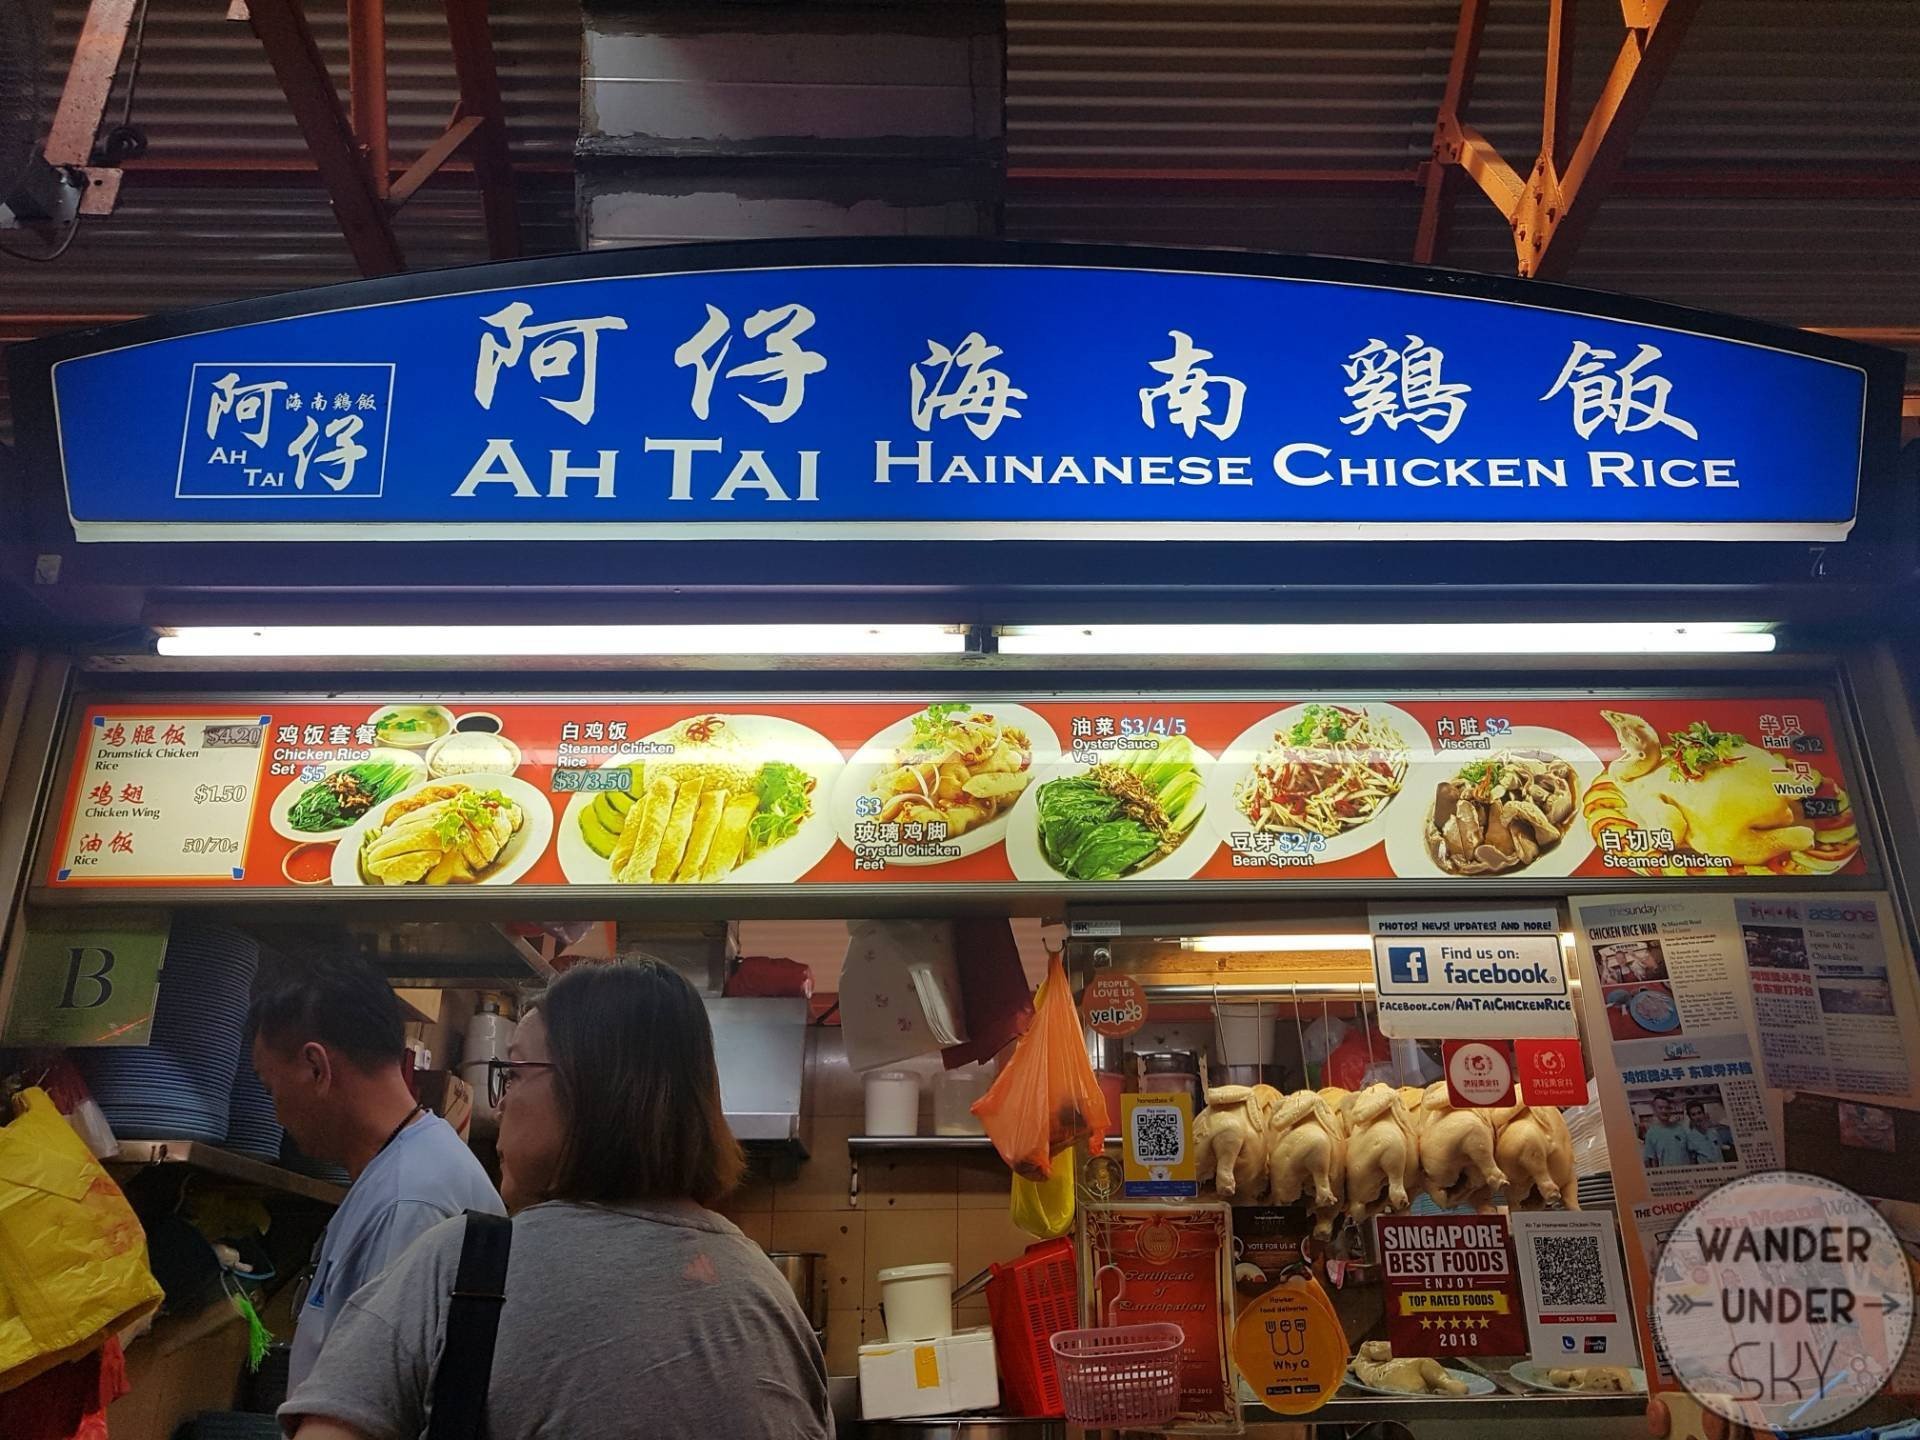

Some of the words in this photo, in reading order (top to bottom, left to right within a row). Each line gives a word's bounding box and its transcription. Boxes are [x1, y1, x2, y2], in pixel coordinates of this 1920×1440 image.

[475, 302, 827, 425] 阿仔
[208, 447, 247, 464] AH
[452, 440, 618, 498] AH
[645, 437, 819, 501] TAI
[875, 440, 1253, 486] HAINANESE
[1273, 444, 1567, 488] CHICKEN
[1588, 452, 1739, 488] RICE
[244, 469, 284, 487] TAI
[561, 721, 629, 742] 白鸡饭
[1071, 716, 1115, 737] 油菜
[1120, 716, 1187, 736] $3/4/5
[1436, 716, 1480, 737] 内脏
[1485, 717, 1512, 736] $2
[1760, 714, 1805, 736] 半只
[102, 723, 187, 747] 鸡腿饭
[207, 727, 261, 746] $4.20
[276, 724, 377, 746] 鸡饭套餐
[1438, 737, 1491, 750] Visceral
[1763, 735, 1791, 749] Half
[558, 742, 620, 755] Steamed
[620, 742, 675, 755] Chicken
[1073, 738, 1116, 751] Oyster
[1117, 738, 1159, 750] Sauce
[97, 748, 153, 759] Drumstick
[155, 748, 199, 758] Chicken
[273, 748, 334, 761] Chicken
[336, 748, 370, 761] Rice
[556, 755, 588, 768] Rice
[1073, 750, 1099, 765] Veg
[95, 760, 119, 771] Rice
[270, 763, 296, 776] Set
[300, 765, 326, 783] $5
[1769, 761, 1815, 782] 一只
[553, 770, 632, 792] $3/3.50
[88, 781, 145, 806] 鸡翅
[194, 784, 247, 804] $1.50
[1773, 783, 1816, 797] Whole
[85, 807, 129, 818] Chicken
[131, 807, 160, 820] Wing
[855, 796, 882, 816] $3
[1805, 800, 1837, 816] $24
[854, 822, 948, 844] 玻璃鸡脚
[1600, 828, 1674, 852] 白切鸡
[79, 831, 134, 854] 油饭
[854, 844, 904, 858] Crystal
[905, 844, 960, 857] Chicken
[1231, 832, 1276, 853] 豆芽
[1278, 832, 1328, 854] $2/3
[73, 855, 98, 866] Rice
[854, 857, 886, 871] Feet
[1232, 854, 1268, 868] Bean
[1269, 854, 1315, 869] Sprout
[1603, 854, 1669, 868] Steamed
[1671, 853, 1733, 868] Chicken
[1378, 920, 1418, 931] PHOTOS!
[1422, 920, 1450, 931] NEWS!
[1453, 920, 1497, 931] UPDATES!
[1501, 920, 1520, 931] AND
[1523, 920, 1552, 931] MORE!
[1589, 926, 1622, 941] CHICKEN
[1622, 924, 1640, 937] RICE
[1639, 922, 1658, 936] WAR
[1441, 947, 1474, 960] Find
[1476, 949, 1493, 960] us
[1497, 949, 1520, 960] on:
[56, 947, 115, 1009] B
[1444, 961, 1550, 984] facebook
[1093, 989, 1119, 998] LOVE
[1121, 988, 1135, 997] US
[1097, 980, 1129, 989] PEOPLE
[1091, 1007, 1125, 1025] yelp
[1634, 1208, 1652, 1219] THE
[1383, 1224, 1505, 1250] SINGAPORE
[1389, 1251, 1436, 1275] BEST
[1442, 1250, 1504, 1273] FOODS
[1425, 1277, 1475, 1289] ENJOY
[1408, 1295, 1428, 1307] TOP
[1429, 1294, 1461, 1307] RATED
[1462, 1294, 1494, 1306] FOODS
[1439, 1332, 1478, 1347] 2018
[1273, 1359, 1298, 1371] Why
[1300, 1359, 1310, 1369] Q
